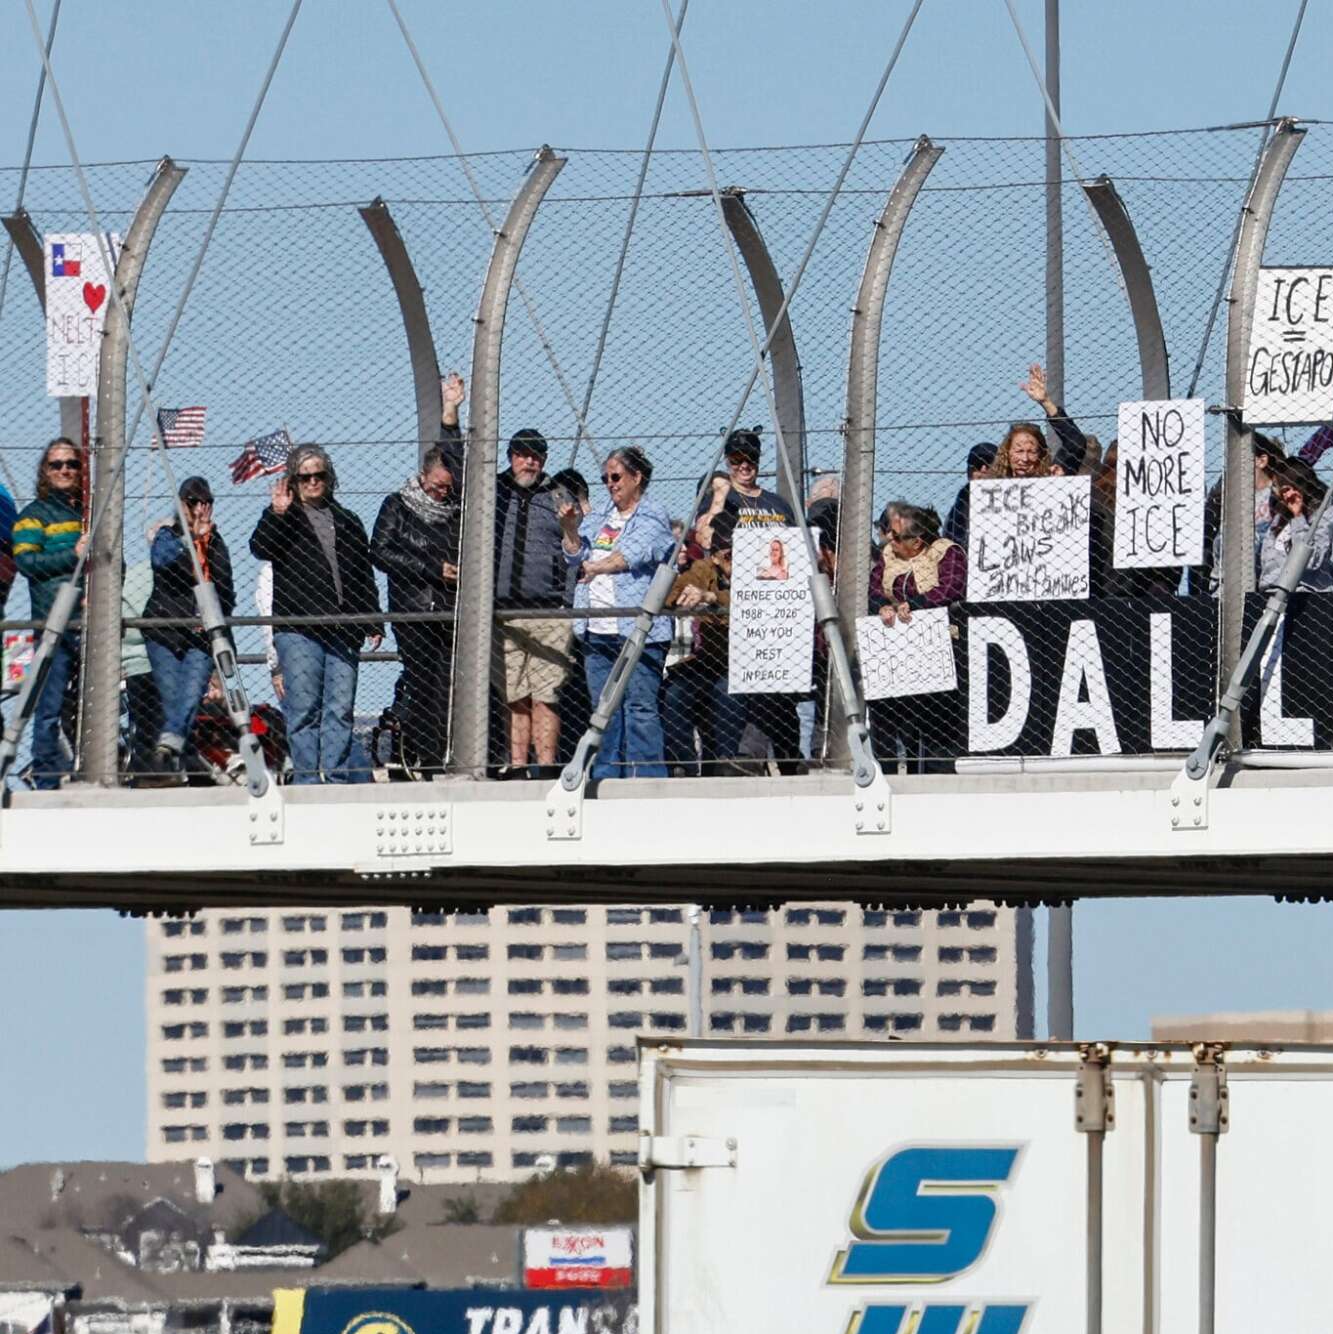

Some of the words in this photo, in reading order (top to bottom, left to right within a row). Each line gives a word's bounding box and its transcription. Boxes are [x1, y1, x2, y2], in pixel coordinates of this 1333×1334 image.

[1268, 275, 1333, 325] ICE
[1141, 409, 1185, 451] NO
[1125, 451, 1192, 497] MORE
[980, 483, 1037, 513] ICE
[1126, 504, 1188, 558] ICE
[737, 589, 771, 601] RENEE
[775, 589, 807, 601] GOOD
[741, 609, 763, 620] 1988
[747, 627, 768, 640] MAY
[771, 626, 793, 639] YOU
[756, 648, 783, 660] REST
[755, 670, 790, 681] PEACE
